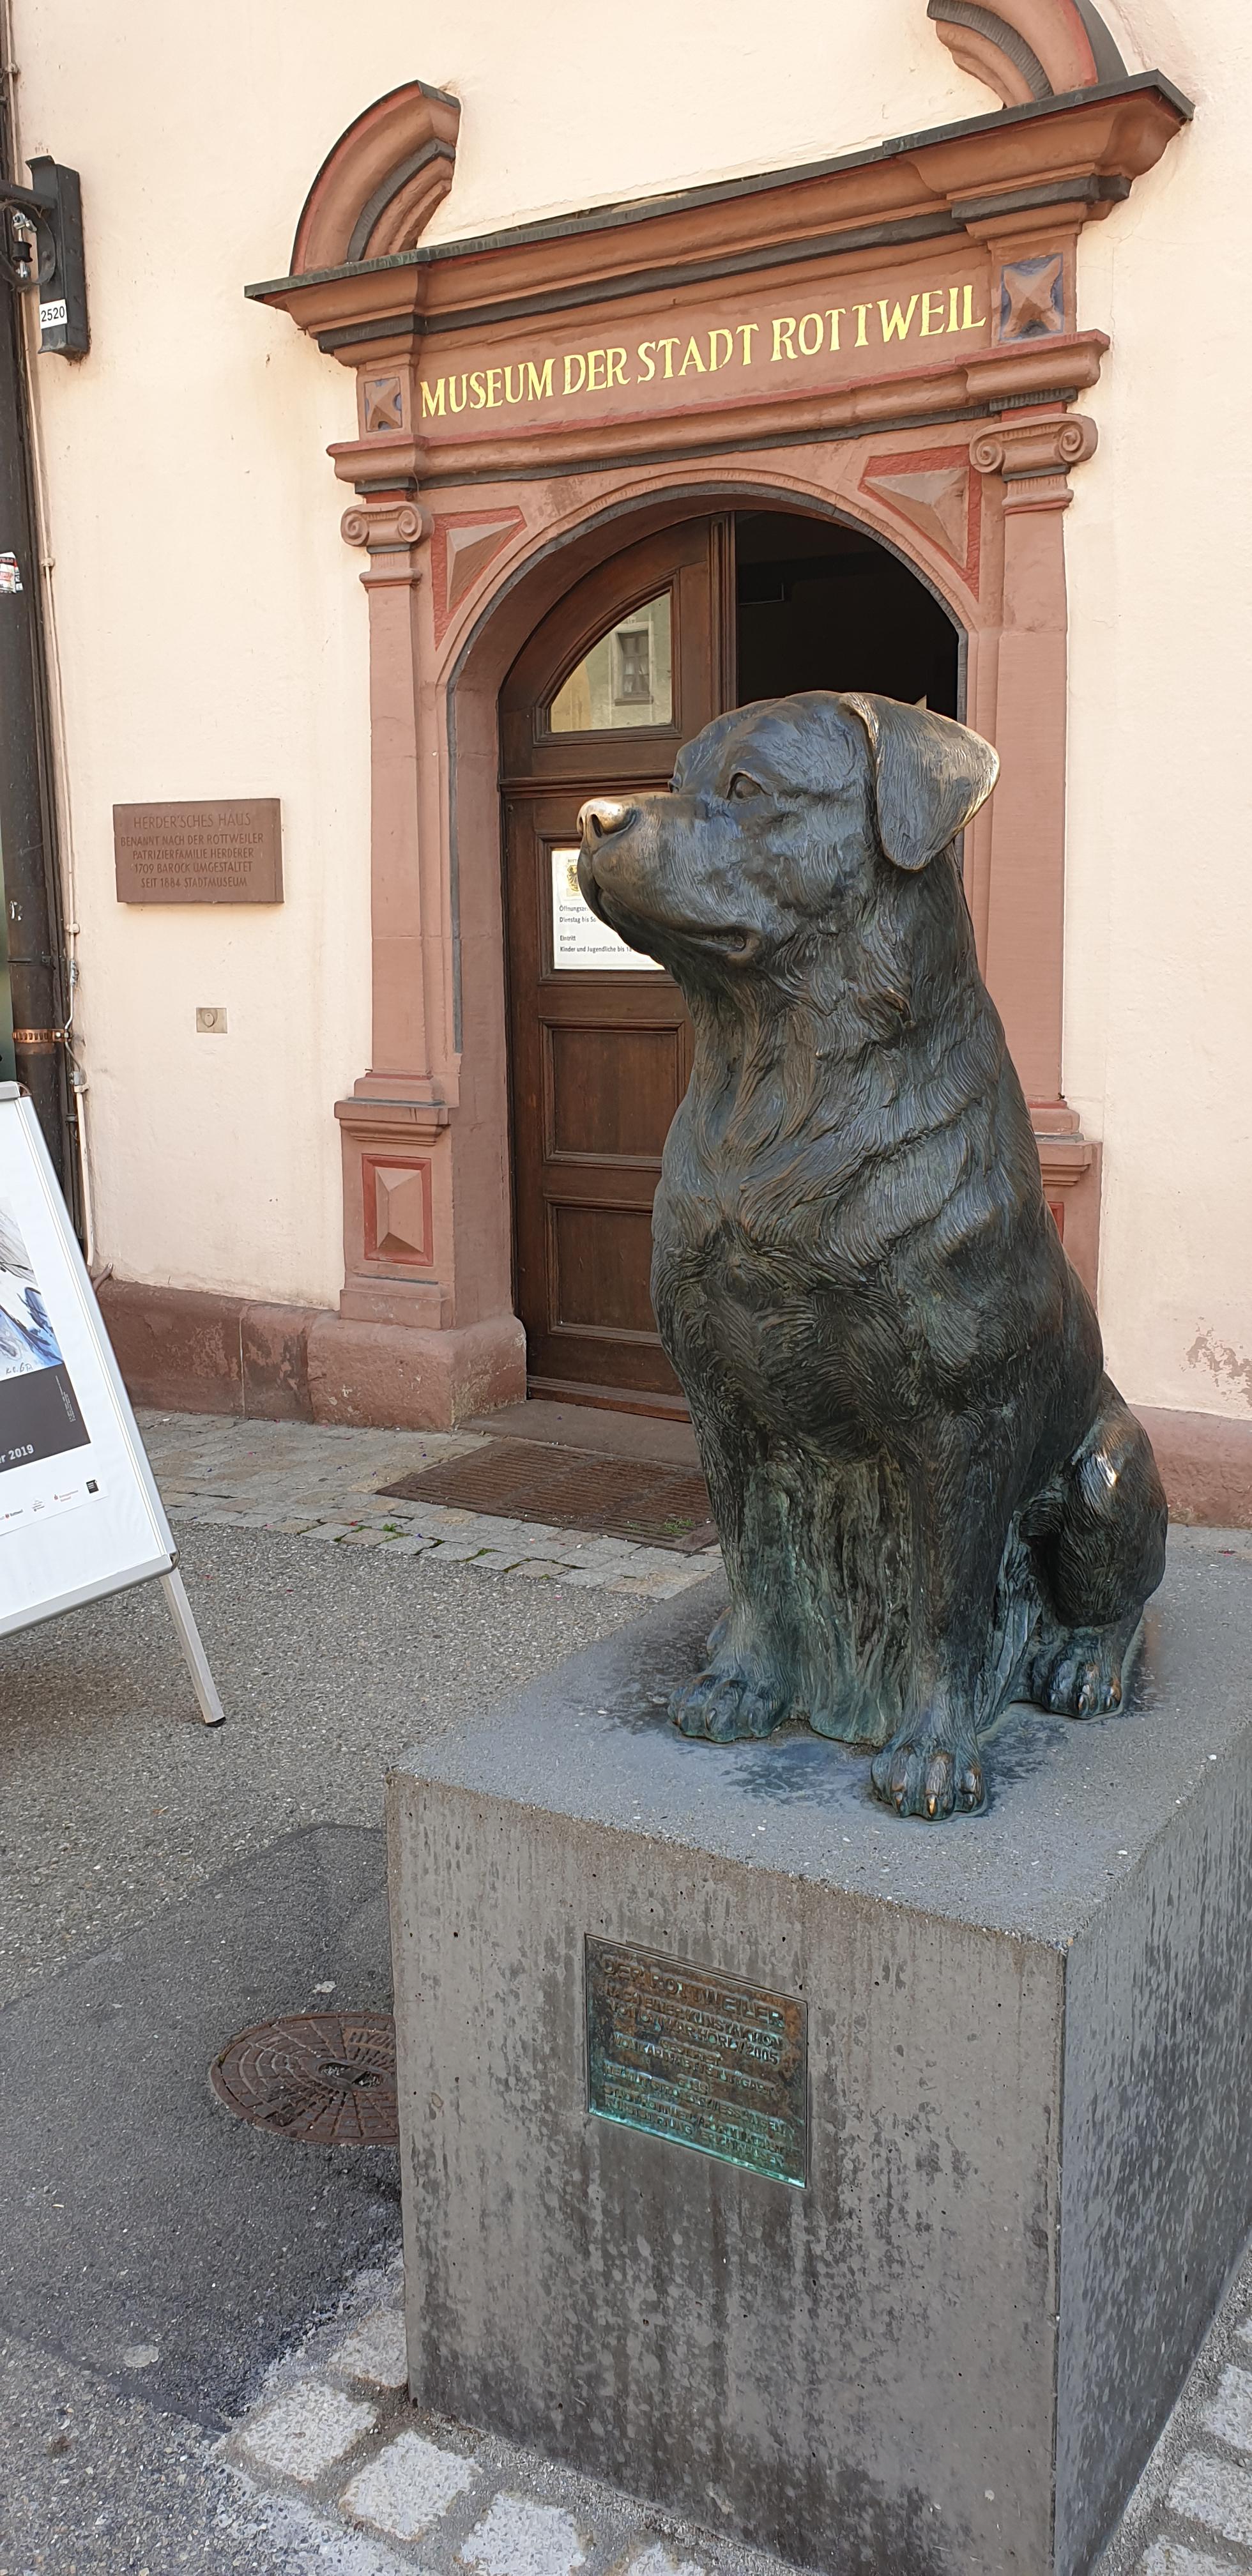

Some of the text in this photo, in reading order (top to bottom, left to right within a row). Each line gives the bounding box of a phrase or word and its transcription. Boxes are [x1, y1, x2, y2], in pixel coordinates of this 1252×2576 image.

[41, 306, 65, 322] 2520
[420, 284, 986, 418] MUSEUM DER STADT ROTTWEIL
[218, 813, 251, 827] HAUS
[121, 832, 264, 847] BENANNT NACH DER ROTTWEILER
[133, 847, 254, 860] PATRIZIERFAMILIE HERDERER
[134, 861, 253, 874] 1709 BAROCK UMGESTALTET
[141, 877, 247, 888] SEIT 1884 STADTMUSEUM
[8, 1444, 34, 1460] 2019
[650, 1970, 784, 2030] ROTTWEILER
[745, 2041, 778, 2066] 2005
